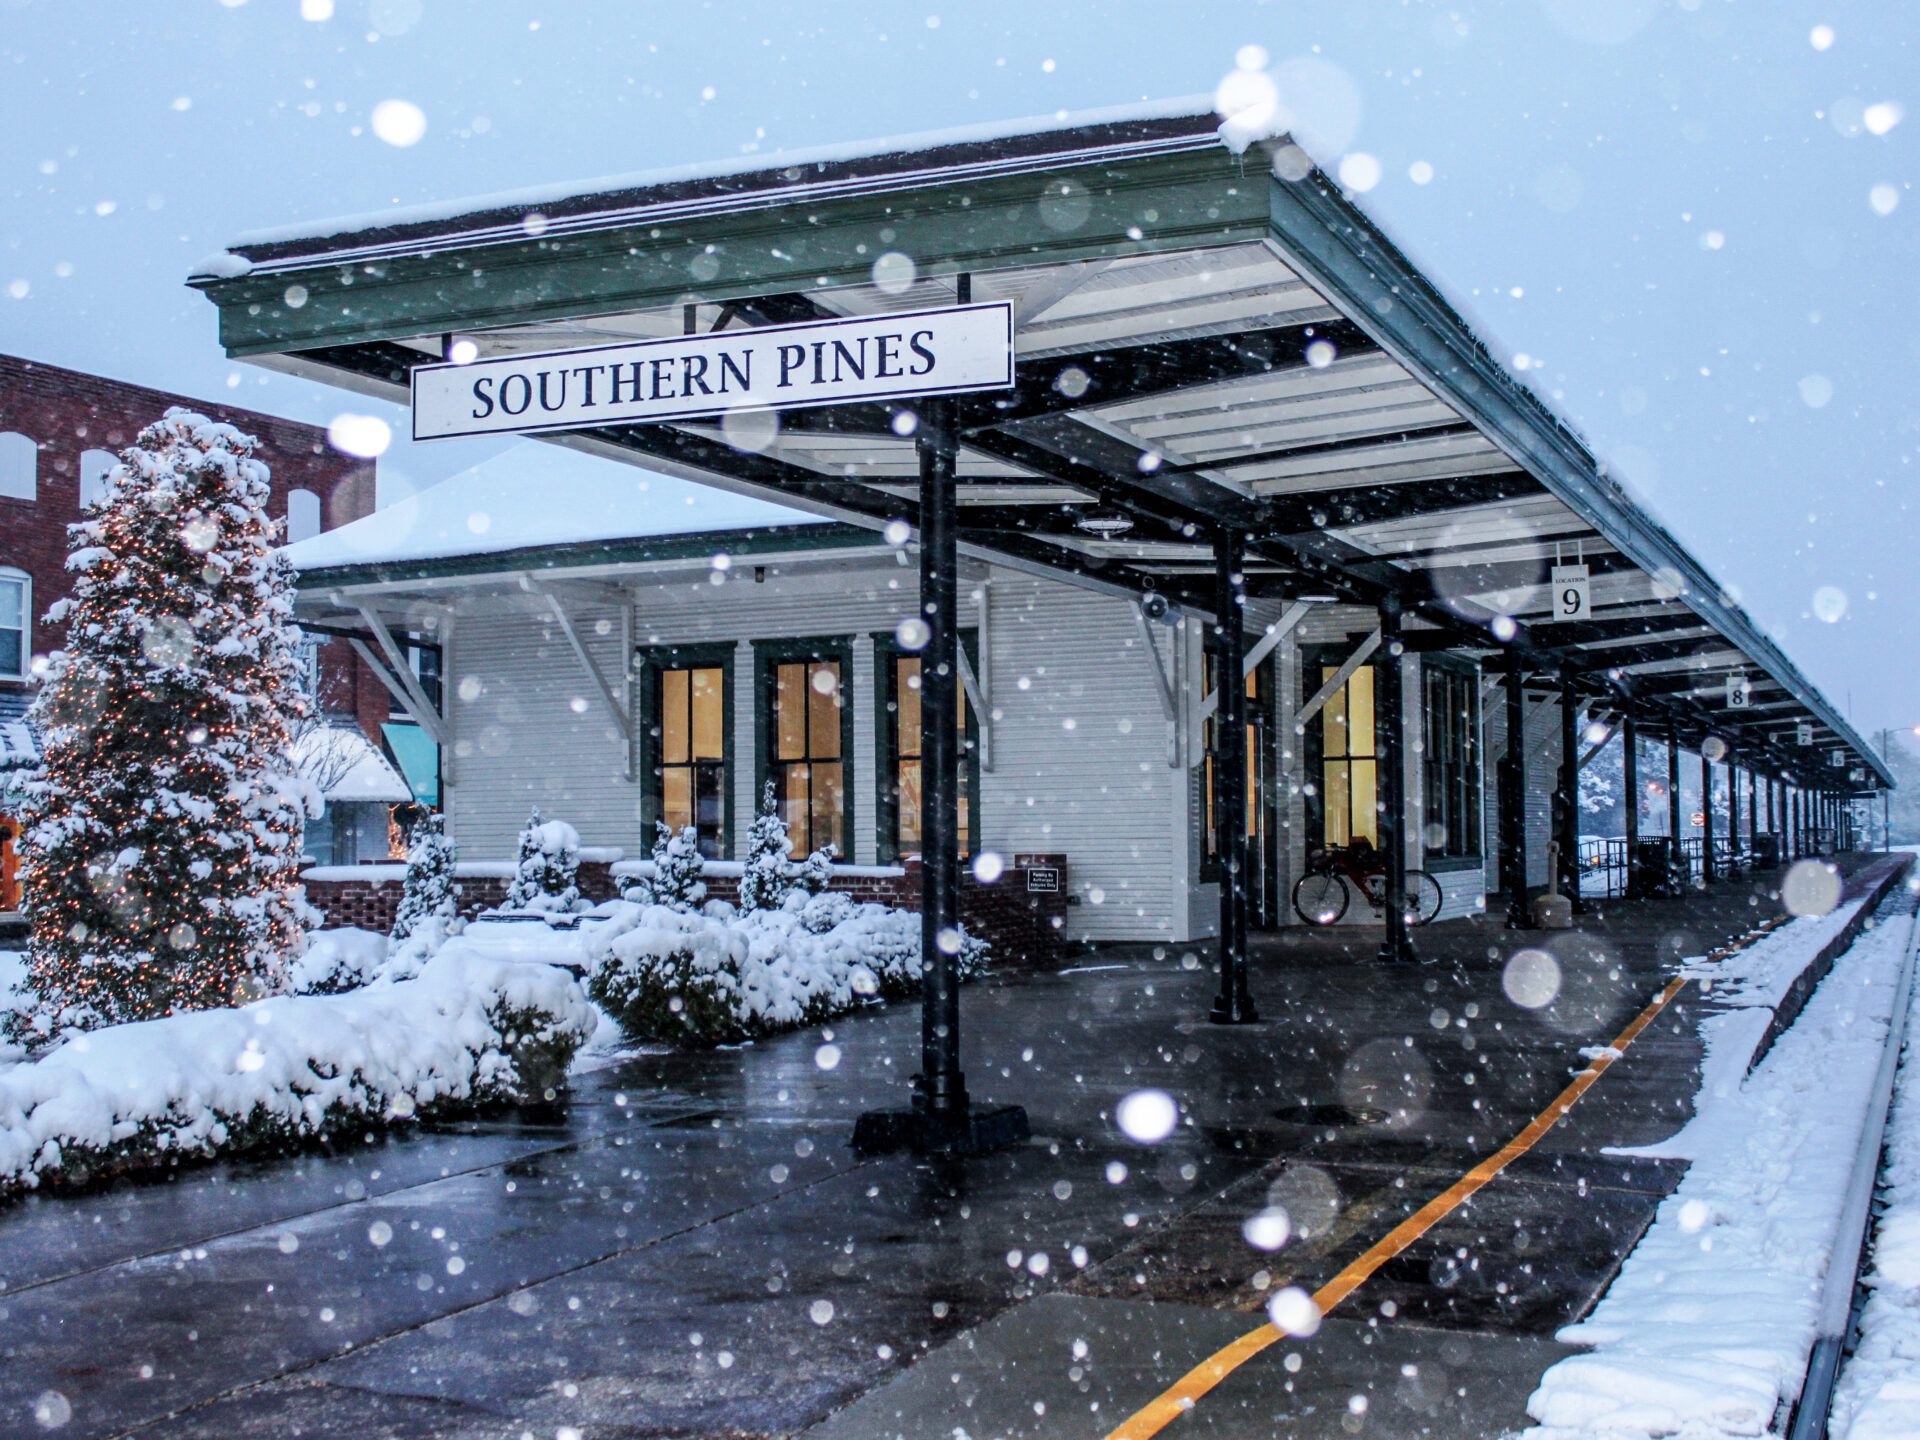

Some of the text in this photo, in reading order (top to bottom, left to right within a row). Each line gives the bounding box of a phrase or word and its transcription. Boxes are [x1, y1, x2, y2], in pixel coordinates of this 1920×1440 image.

[472, 330, 937, 419] SOUTHERN PINES
[1562, 588, 1581, 615] 9
[1732, 689, 1744, 705] 8
[1801, 733, 1809, 744] 7
